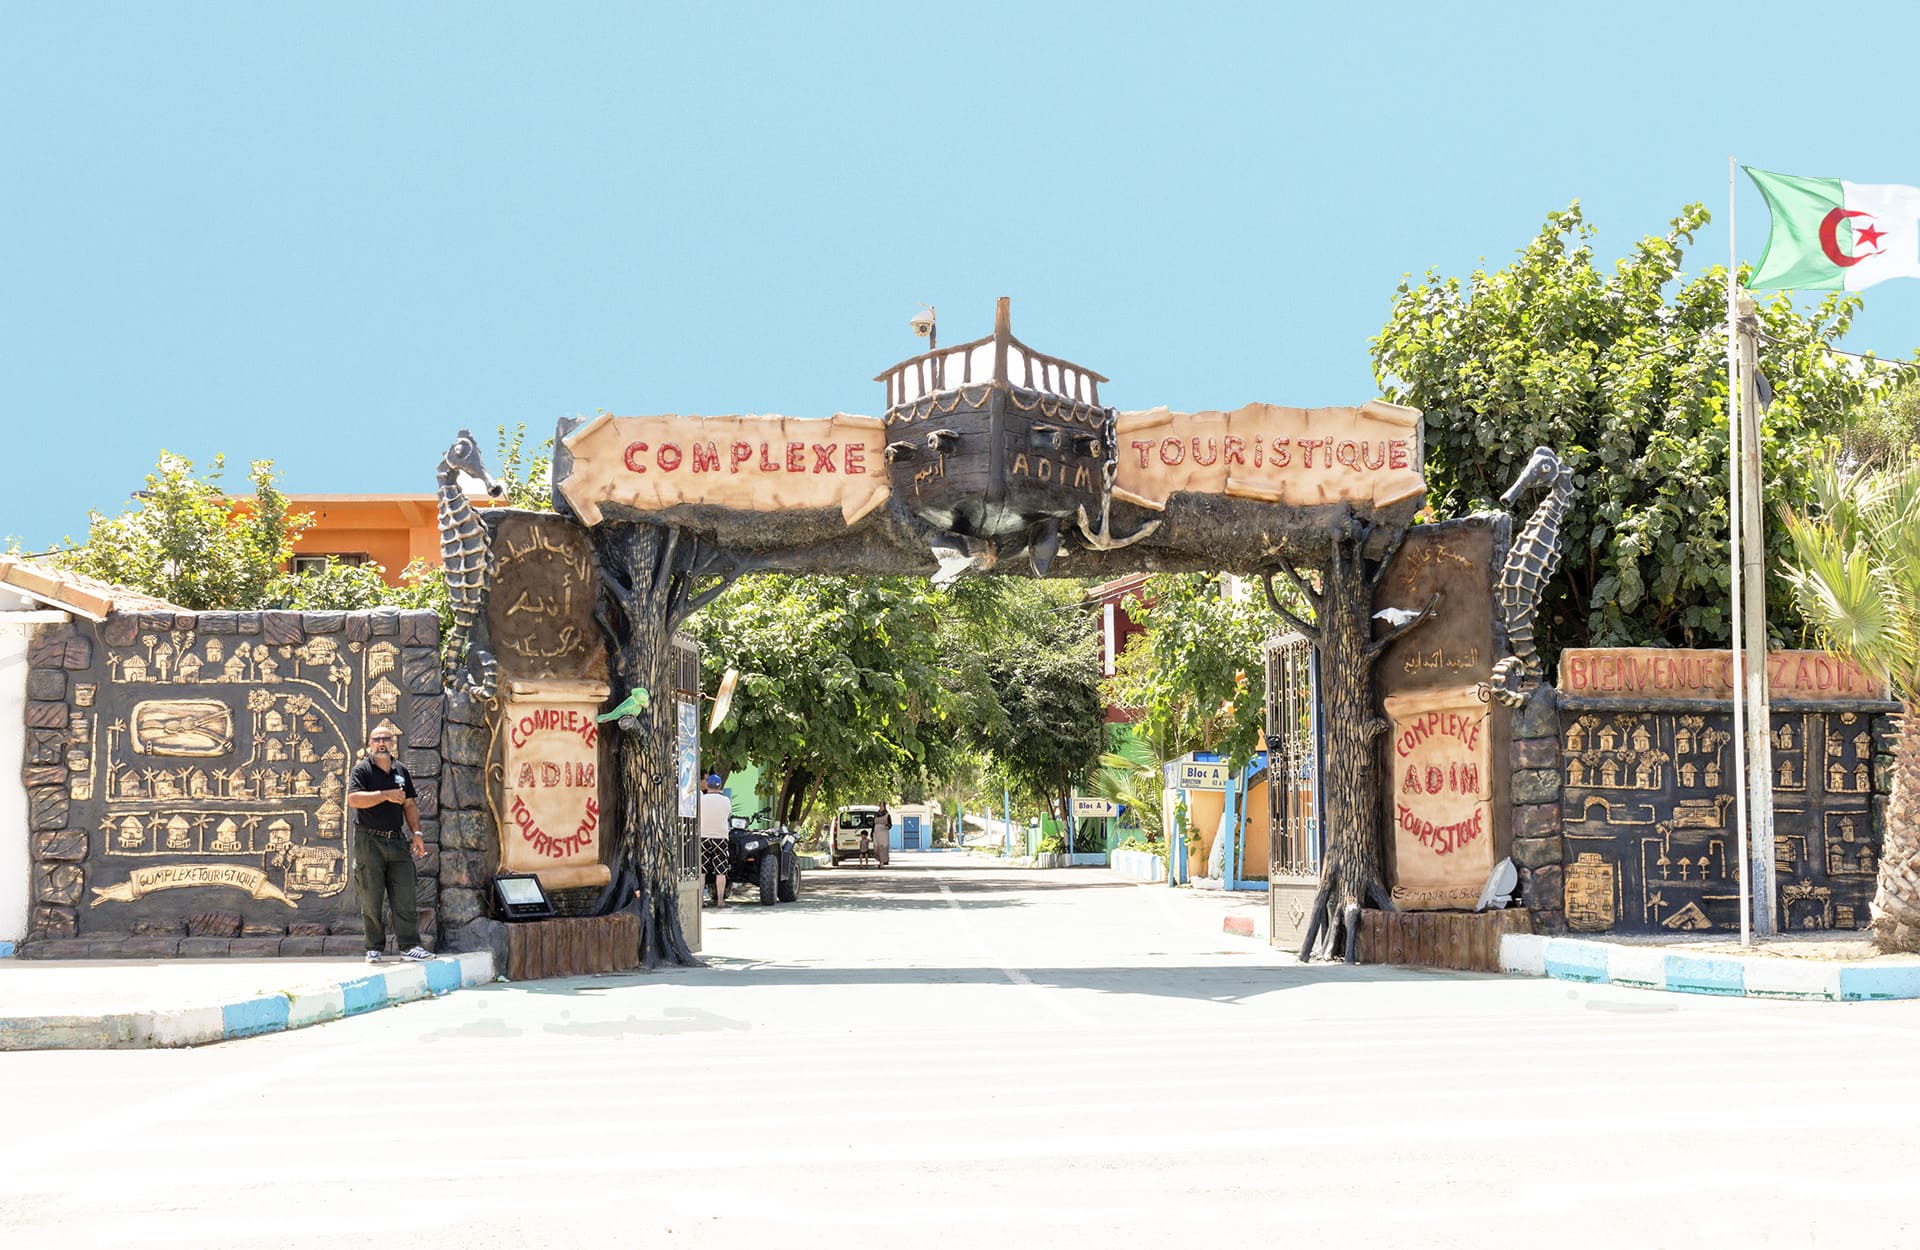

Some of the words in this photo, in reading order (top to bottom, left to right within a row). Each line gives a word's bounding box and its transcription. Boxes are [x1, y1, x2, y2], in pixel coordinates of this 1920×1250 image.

[623, 440, 866, 474] COMPLEXE
[1571, 656, 1714, 691] BIENVENUE
[511, 709, 599, 750] COMPLEXE
[1397, 712, 1480, 758] COMPLEXE
[518, 761, 596, 788] ADIM
[1187, 767, 1208, 778] Bloc
[1212, 768, 1220, 779] A
[1401, 761, 1481, 796] ADIM
[1078, 802, 1094, 810] Bloc
[1096, 802, 1102, 810] A
[510, 795, 600, 859] TOURISTIQUE
[1397, 803, 1483, 856] TOURISTIQUE
